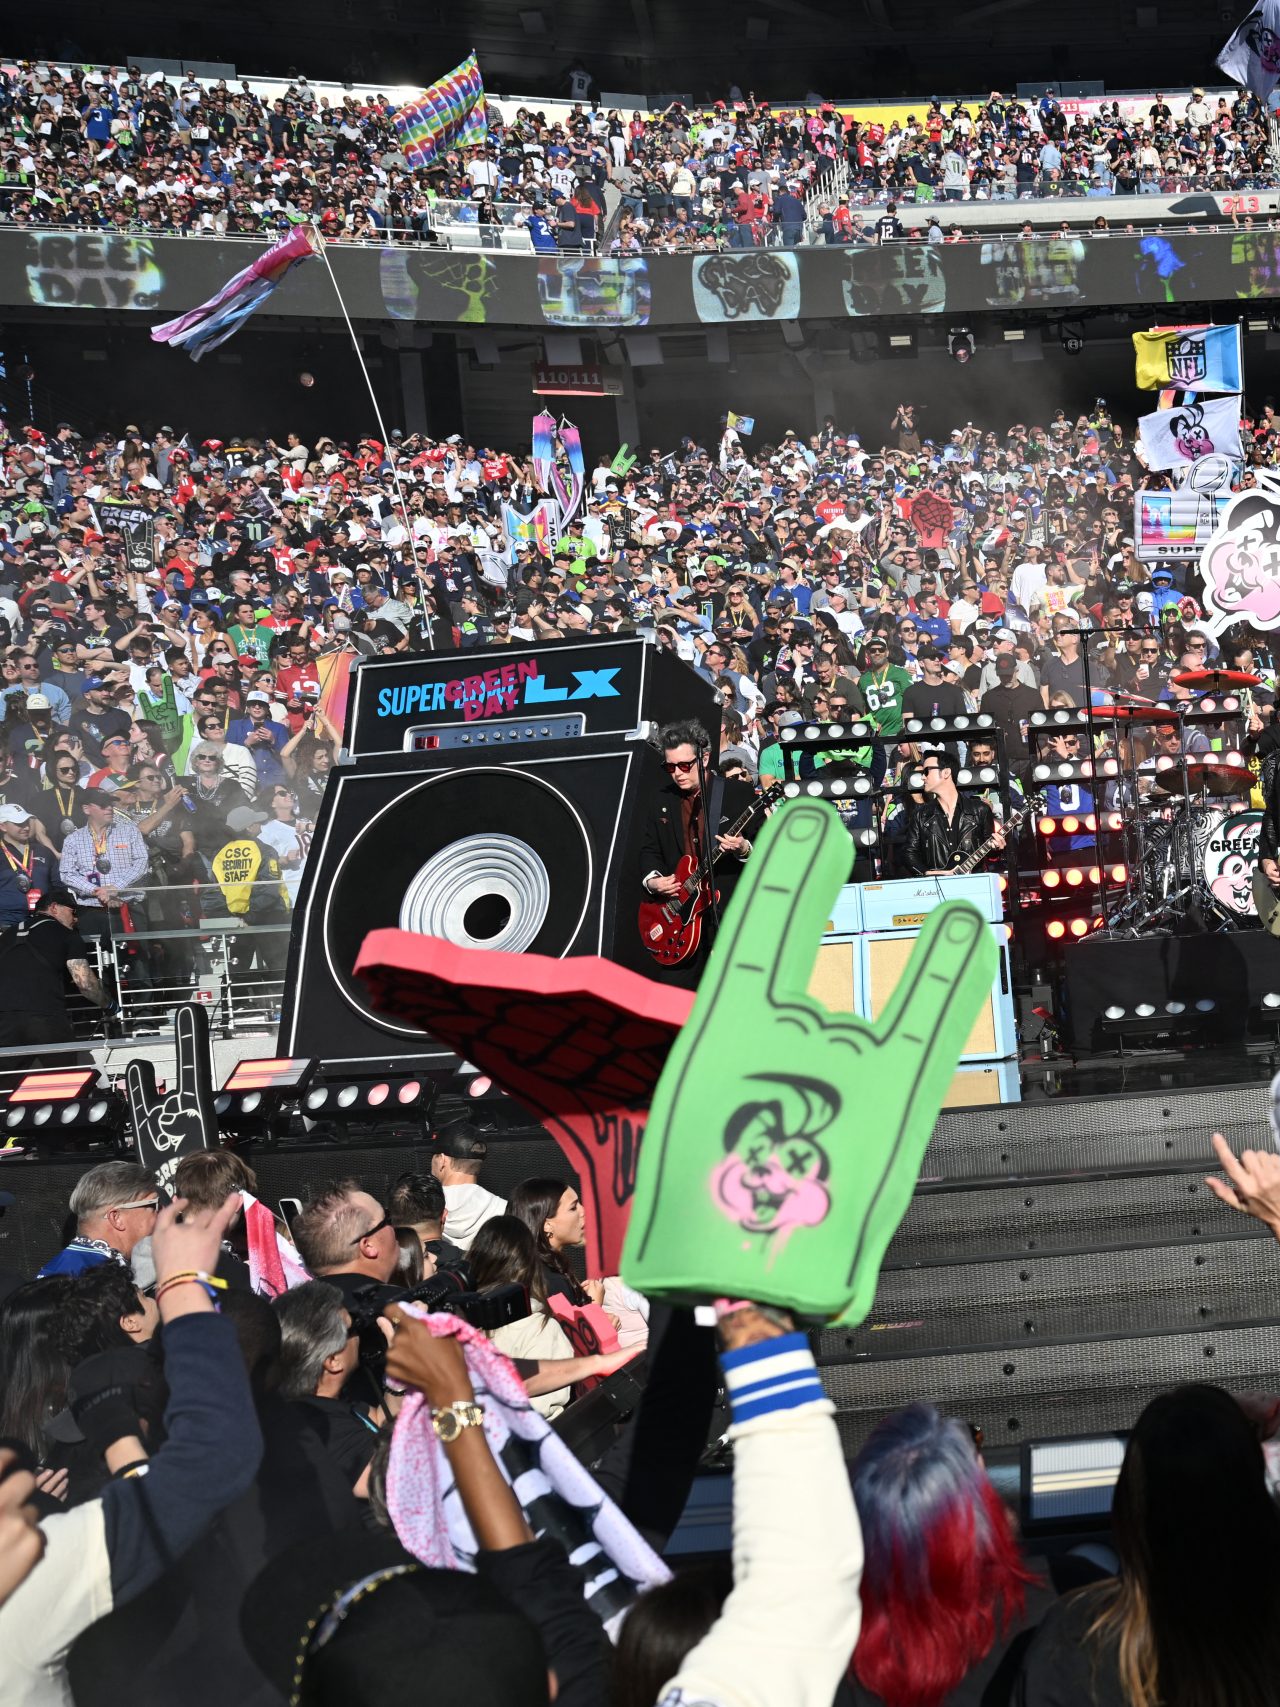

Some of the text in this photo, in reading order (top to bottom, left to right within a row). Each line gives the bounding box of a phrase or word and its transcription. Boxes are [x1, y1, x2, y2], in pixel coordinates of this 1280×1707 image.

[1222, 196, 1260, 214] 213
[881, 225, 893, 239] 12
[42, 277, 136, 308] DAY
[1169, 357, 1203, 380] NFL
[538, 372, 601, 385] 110 111
[100, 505, 153, 524] GREEN
[246, 522, 262, 541] 11
[1158, 546, 1204, 555] SUPE
[443, 658, 539, 703] GREEN
[377, 682, 447, 717] SUPER
[524, 667, 622, 704] LX
[865, 680, 897, 711] 62
[463, 688, 520, 722] DAY
[225, 847, 250, 859] CSC
[1210, 837, 1260, 852] GREEN
[222, 857, 253, 872] SECURITY
[224, 869, 250, 883] STAFF
